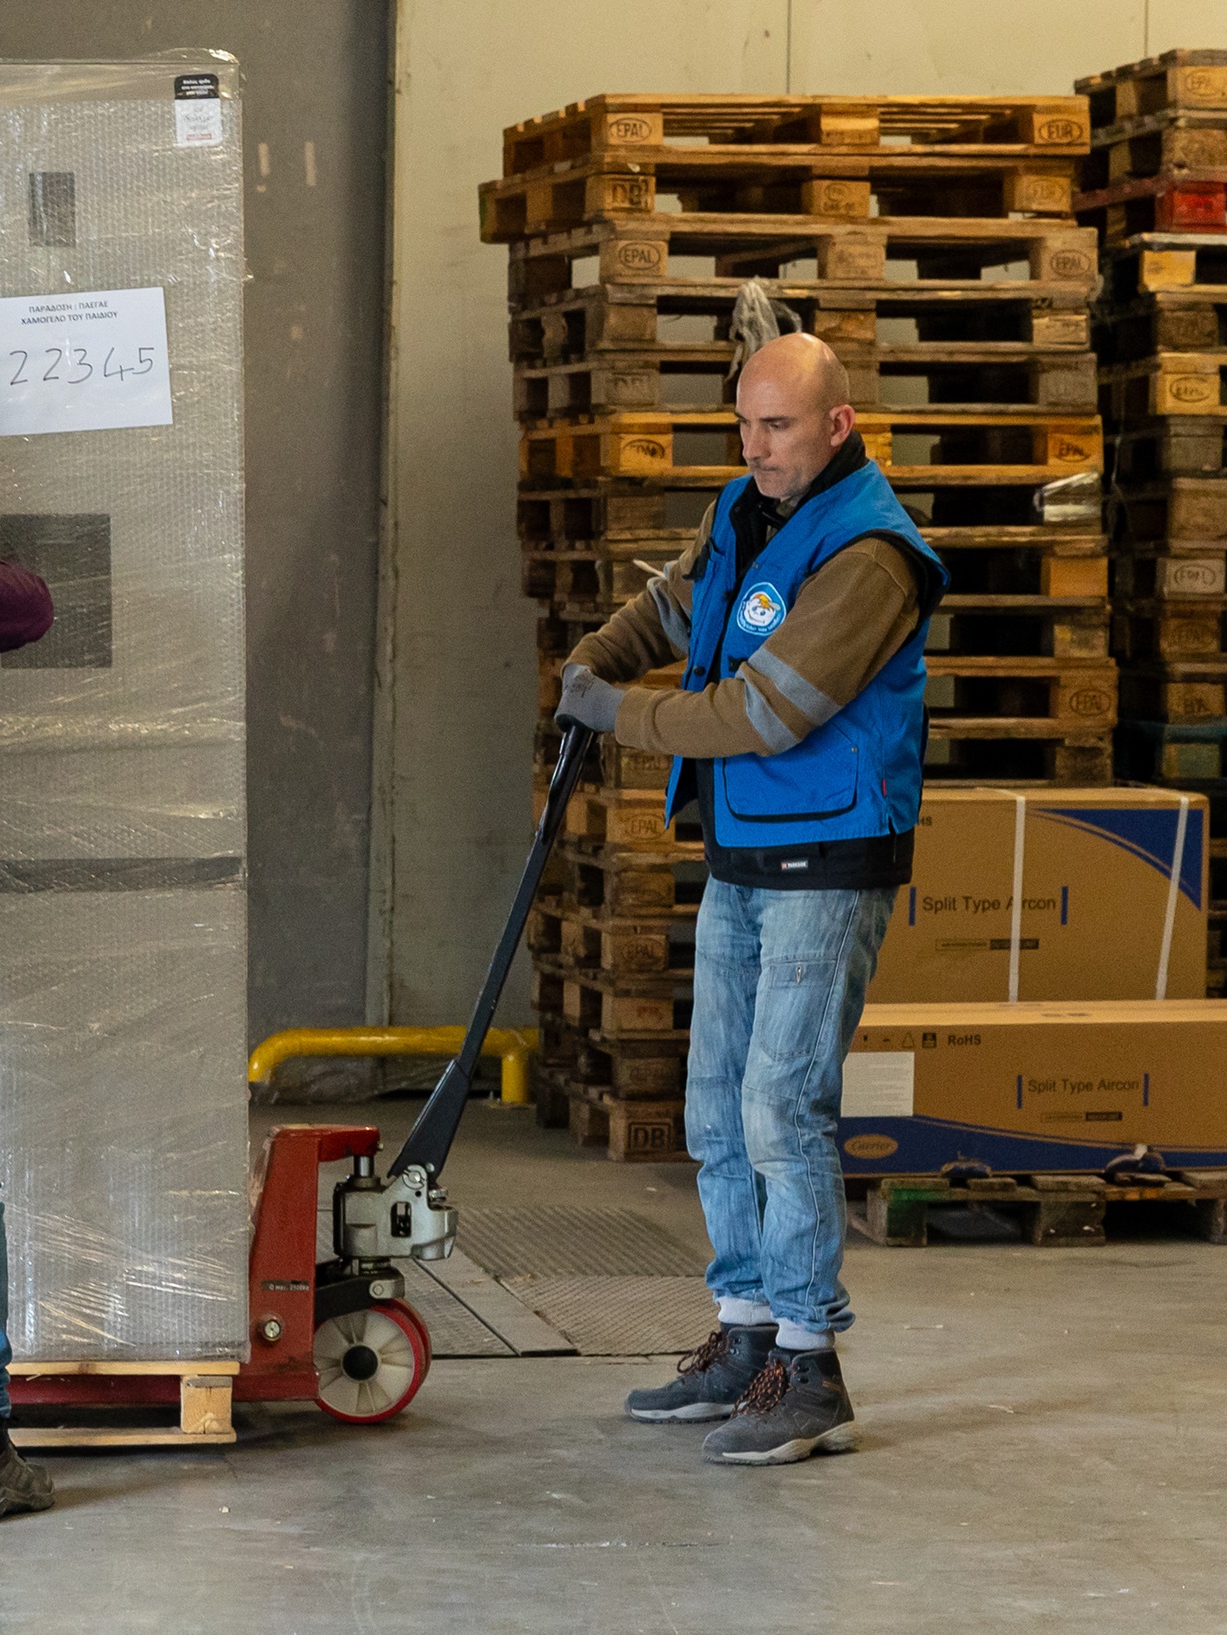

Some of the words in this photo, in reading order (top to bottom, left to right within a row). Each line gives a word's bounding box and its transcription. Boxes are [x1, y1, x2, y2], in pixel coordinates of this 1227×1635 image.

[616, 120, 645, 136] EPAL
[623, 248, 653, 264] EPAL
[29, 303, 73, 314] ΠΑΡΑΔΟΣΗ
[21, 314, 66, 326] ΧΑΜΟΓΕΛΟ
[68, 313, 84, 322] ΤΟΥ
[85, 311, 118, 321] ΠΑΙΔΙΟΥ
[922, 896, 957, 914] Split
[962, 896, 1001, 914] Type
[1005, 896, 1056, 910] Arcon
[948, 1034, 981, 1046] RoHS
[1028, 1079, 1057, 1095] Split
[1061, 1078, 1093, 1094] Type
[1097, 1078, 1140, 1092] Aircon
[634, 1127, 666, 1148] DB
